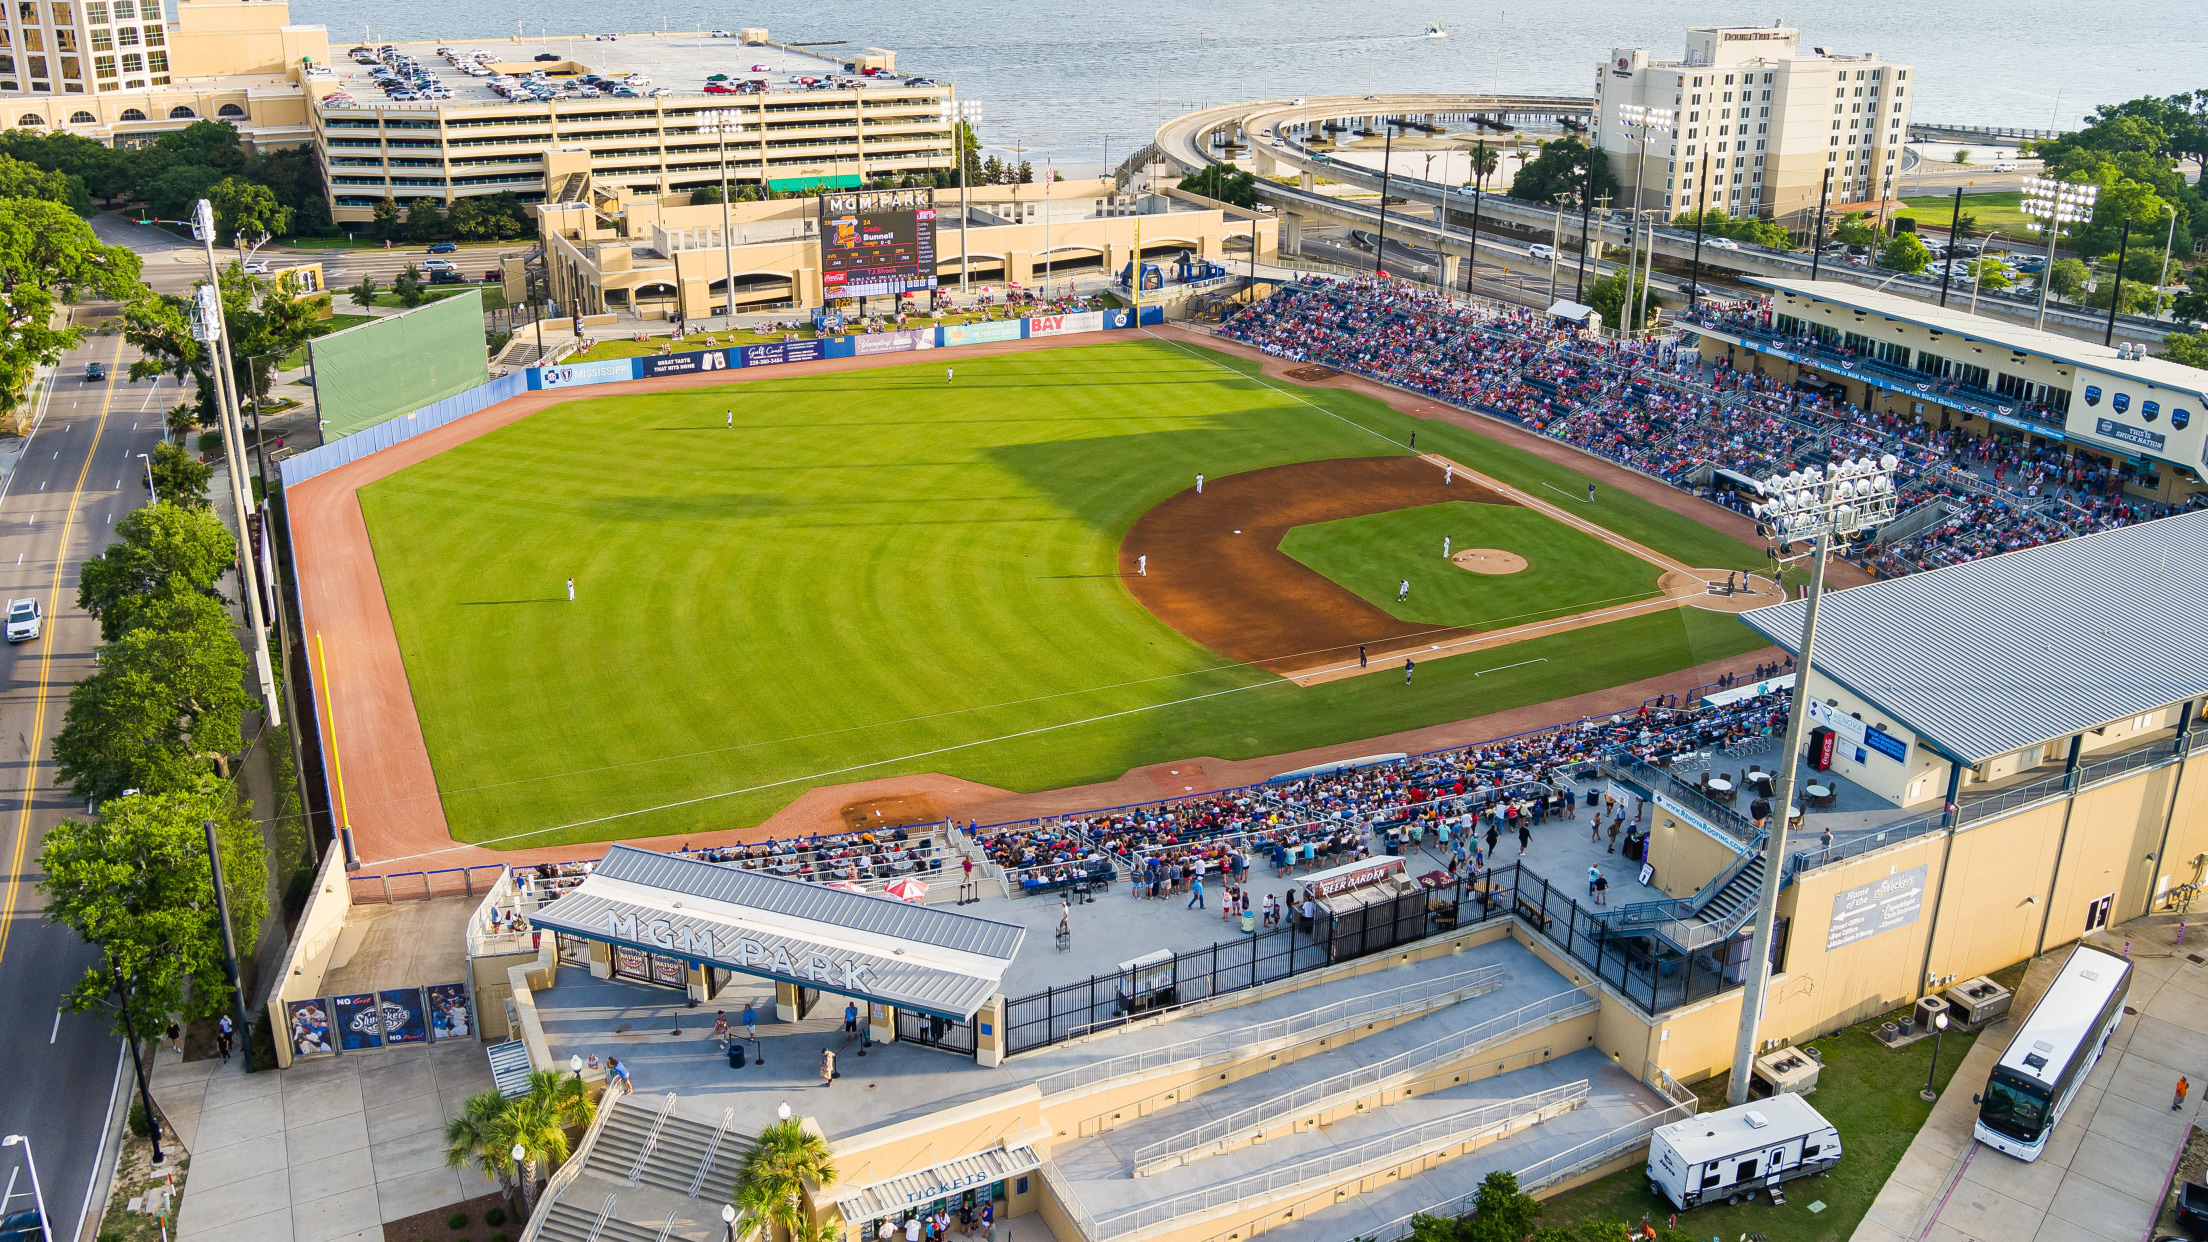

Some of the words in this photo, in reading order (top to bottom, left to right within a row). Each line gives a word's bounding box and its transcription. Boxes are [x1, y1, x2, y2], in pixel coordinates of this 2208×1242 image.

[830, 196, 872, 212] MGM
[880, 193, 927, 208] PARK
[863, 232, 894, 240] Bunnell
[1031, 316, 1064, 332] BAY
[748, 345, 764, 358] Gulf
[766, 346, 785, 354] Coast
[574, 364, 630, 379] MISSISSIPPI
[1820, 364, 1841, 374] Welcome
[1860, 375, 1872, 383] Park
[1890, 384, 1904, 392] Home
[1937, 398, 1962, 410] Shuckers
[2116, 430, 2138, 442] SHUCK
[2138, 437, 2162, 448] NATION
[2129, 428, 2144, 437] THIS
[1833, 714, 1862, 732] RENOVA
[1822, 738, 1832, 765] Coca-Cola
[1322, 880, 1347, 896] BEER
[1348, 868, 1386, 887] GARDEN
[1846, 888, 1870, 900] Home
[1846, 900, 1856, 910] of
[1856, 896, 1868, 906] the
[608, 908, 718, 958] MGM
[740, 938, 873, 994] PARK
[336, 998, 351, 1006] NO
[352, 997, 372, 1005] Grit
[1658, 1158, 1676, 1176] Jayco
[906, 1171, 987, 1204] TICKETS
